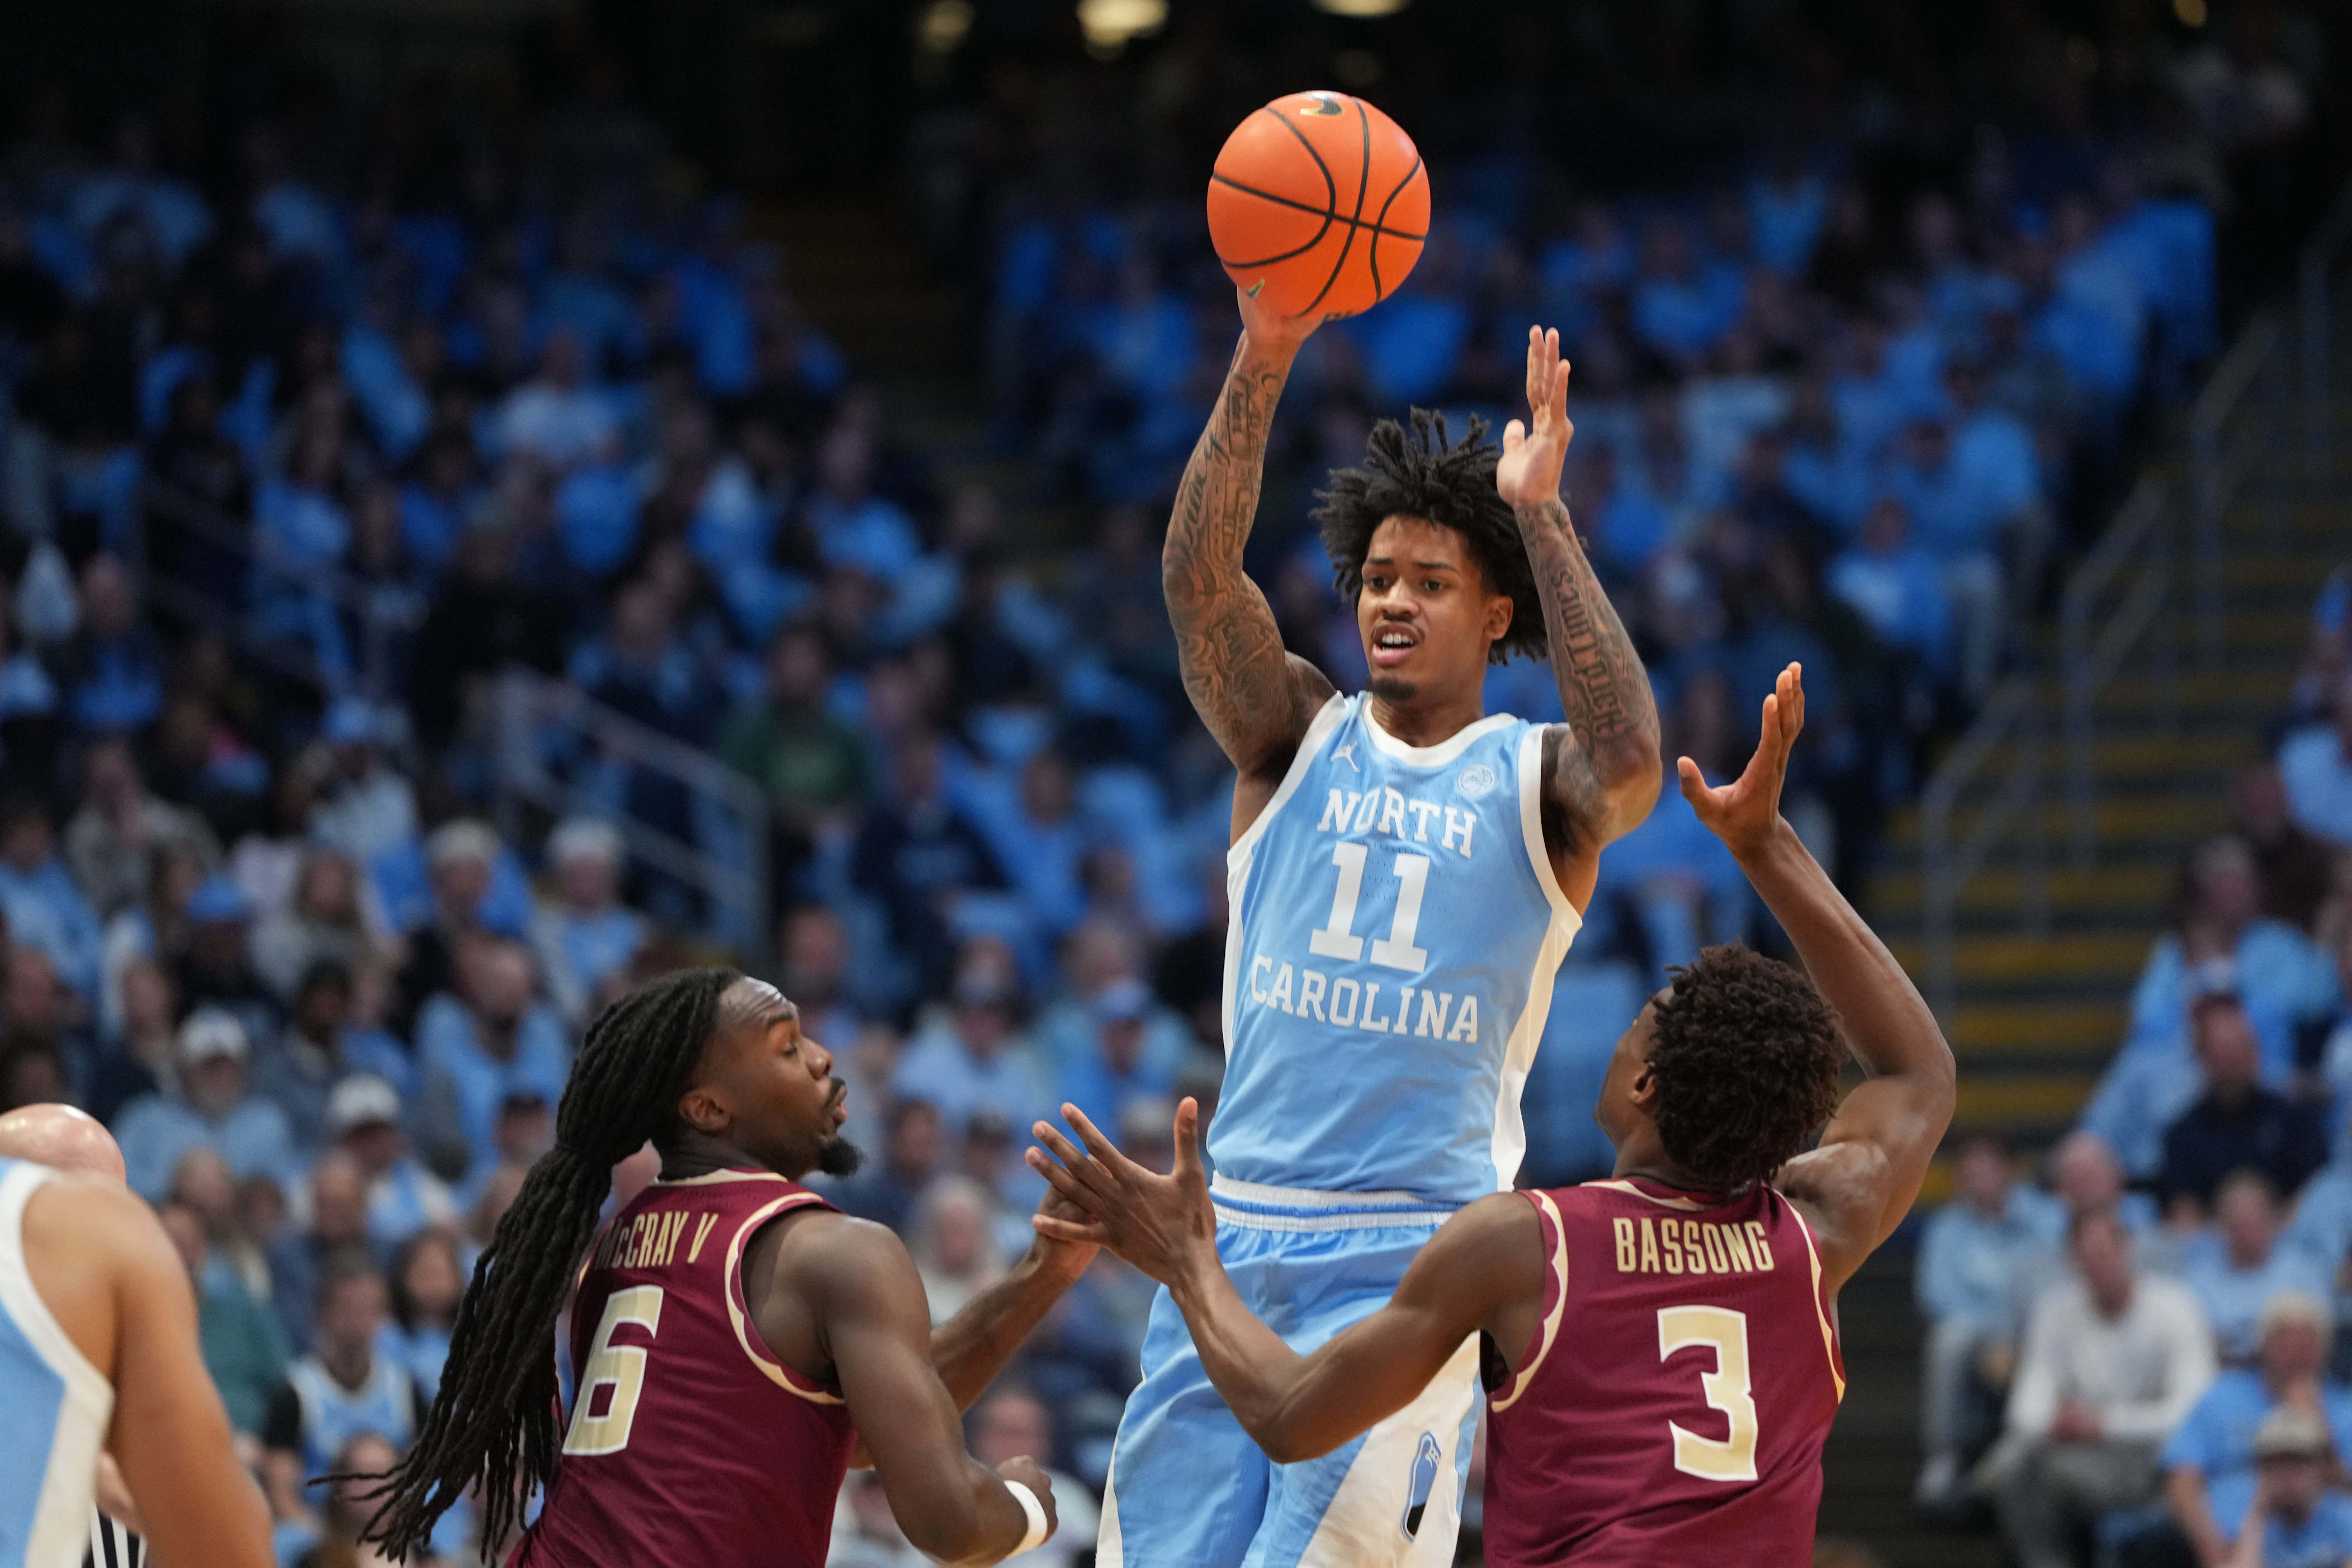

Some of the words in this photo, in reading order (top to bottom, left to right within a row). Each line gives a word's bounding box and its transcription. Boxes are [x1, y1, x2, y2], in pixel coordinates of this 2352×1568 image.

[1317, 786, 1476, 859] NORTH
[1309, 841, 1430, 974] 11
[1251, 954, 1479, 1043] CAROLINA
[687, 1212, 719, 1263] V
[1613, 1218, 1775, 1275] BASSONG
[562, 1285, 664, 1456] 6
[1657, 1304, 1759, 1481] 3
